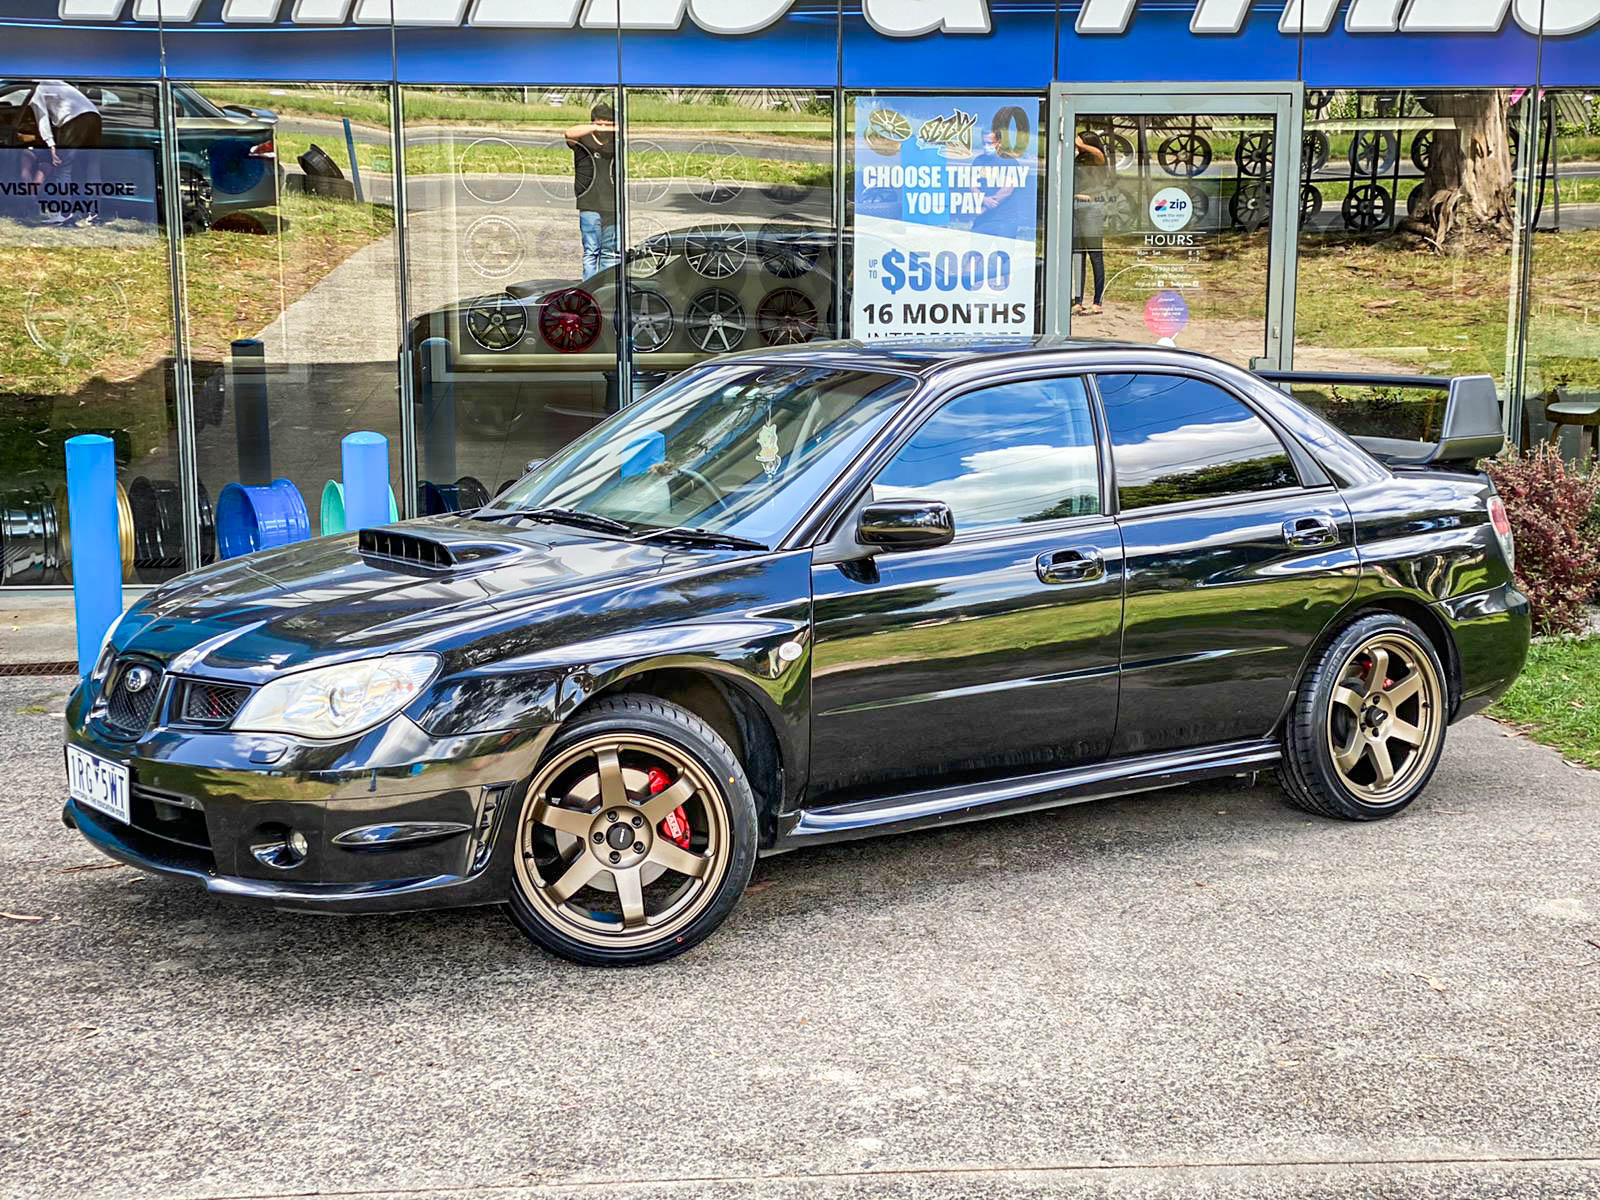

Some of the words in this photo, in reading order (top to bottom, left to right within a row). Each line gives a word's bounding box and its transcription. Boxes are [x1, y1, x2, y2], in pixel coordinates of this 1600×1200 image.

[863, 166, 941, 188] CHOOSE
[946, 166, 981, 188] THE
[984, 166, 1030, 188] WAY
[0, 182, 40, 196] VISIT
[44, 182, 81, 196] OUR
[84, 182, 135, 196] STORE
[38, 200, 98, 214] TODAY!
[906, 192, 945, 214] YOU
[950, 192, 986, 214] PAY
[1169, 199, 1187, 211] zip
[1144, 234, 1194, 246] HOURS
[868, 259, 878, 268] UP
[868, 270, 878, 279] TO
[881, 248, 1011, 294] $5000
[863, 303, 893, 324] 16
[903, 303, 1026, 324] MONTHS
